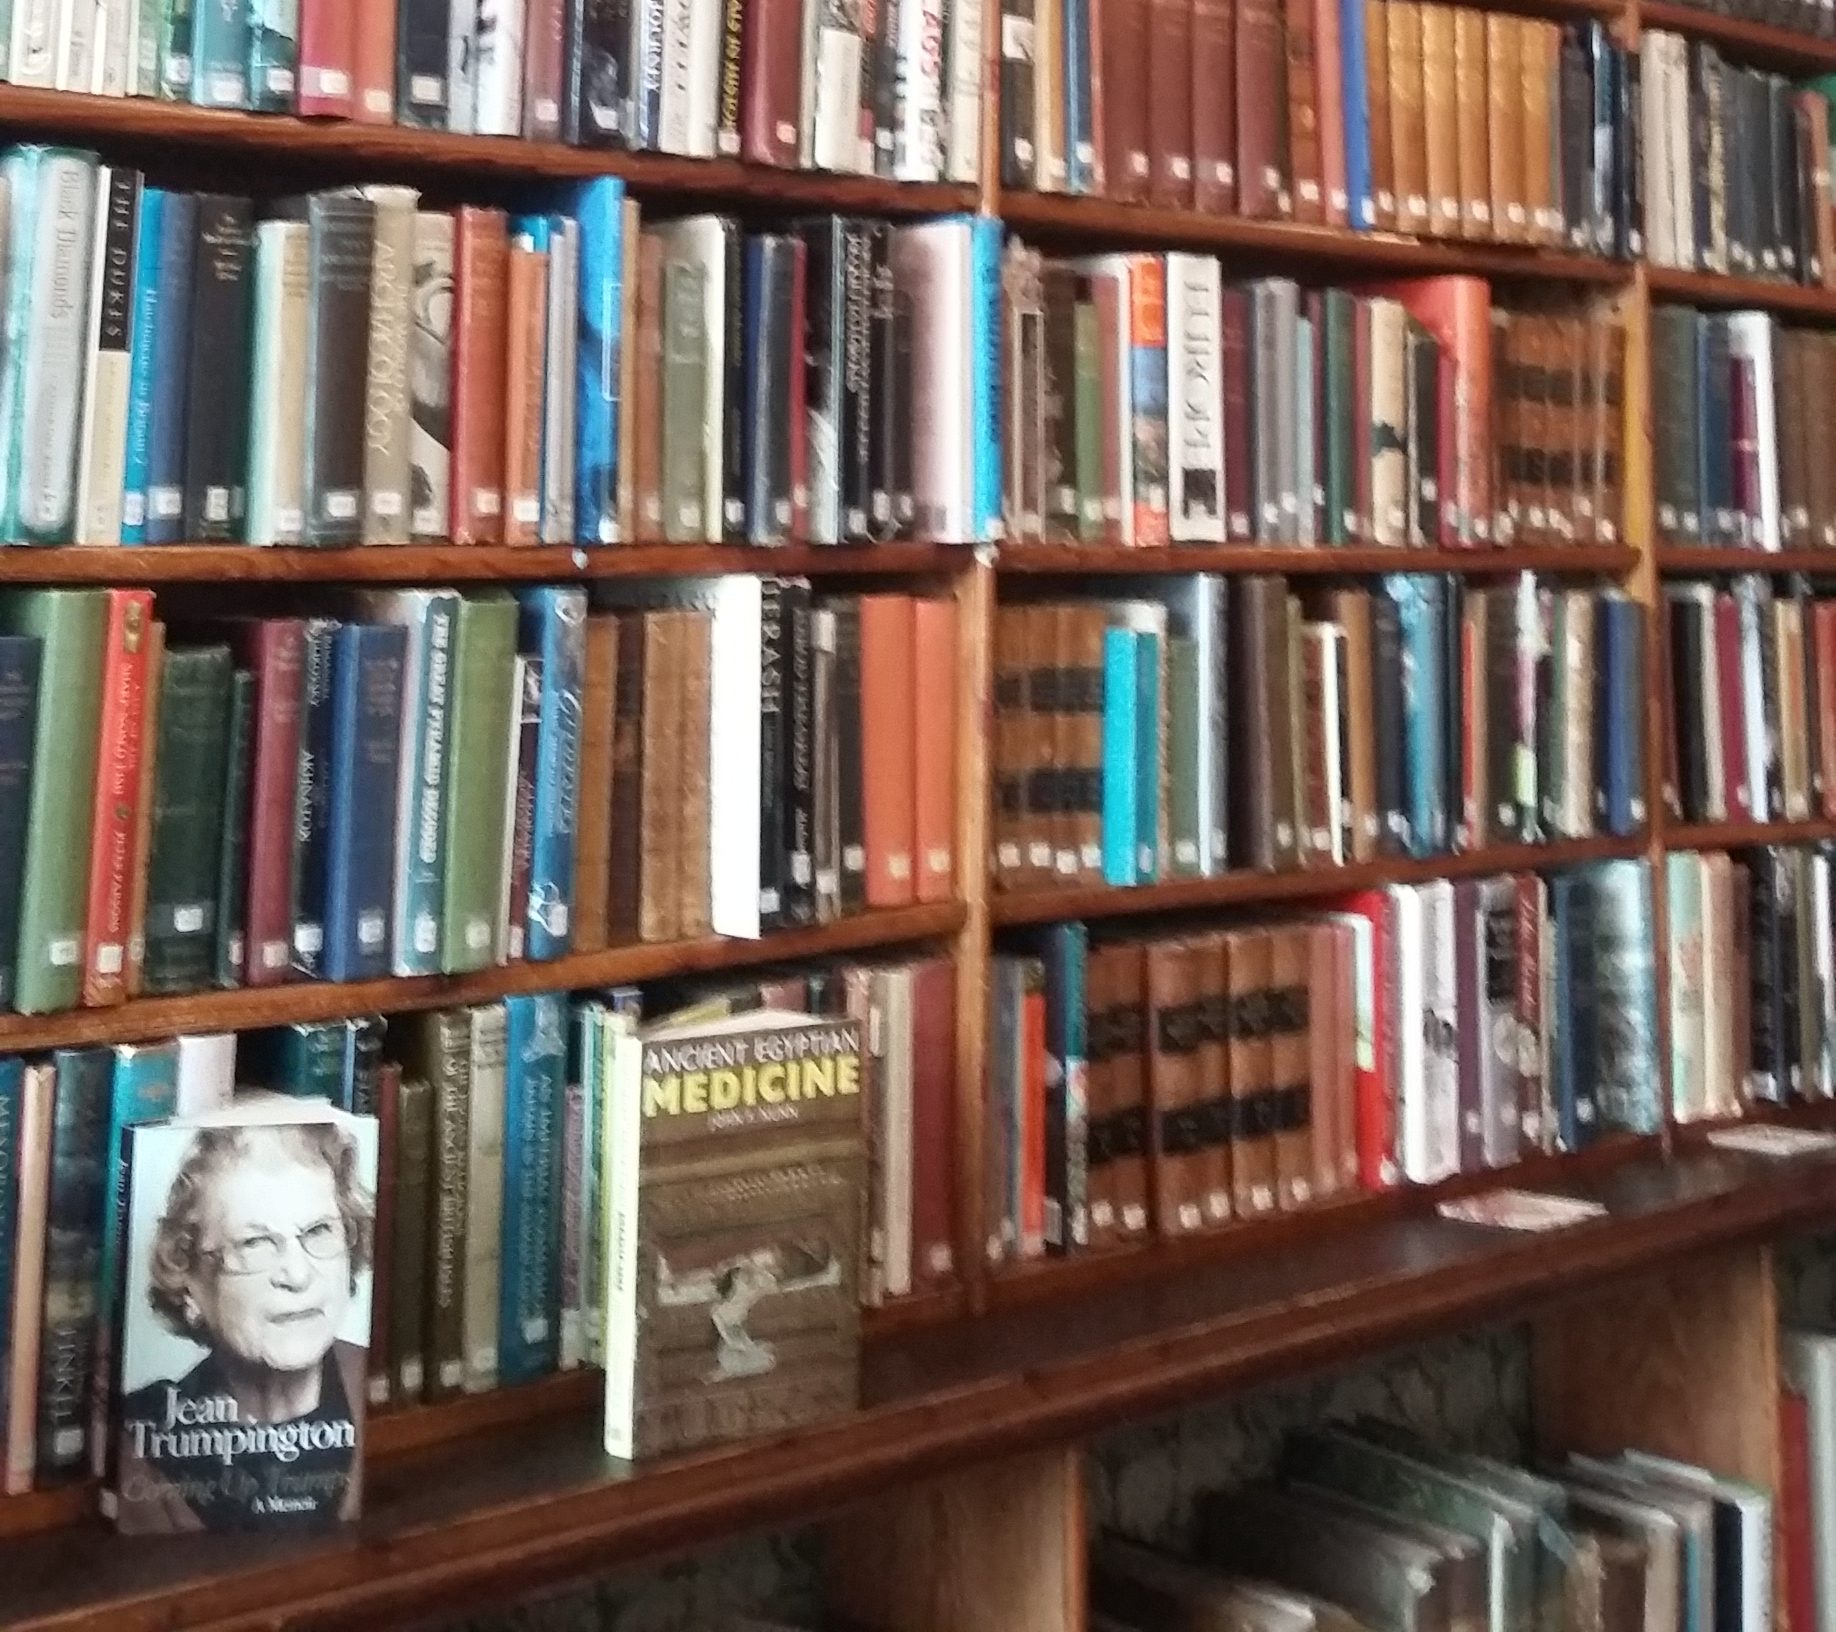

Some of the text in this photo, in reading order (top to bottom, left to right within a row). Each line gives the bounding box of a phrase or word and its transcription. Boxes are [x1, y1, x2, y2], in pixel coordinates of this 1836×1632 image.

[647, 0, 664, 93] JOURNEY
[50, 169, 80, 320] Black Diamonds
[104, 180, 131, 337] THE DUKES
[643, 1026, 861, 1074] ANCIENT EGYPTIAN
[641, 1052, 860, 1118] MEDICINE
[165, 1386, 239, 1430] Jean
[126, 1418, 356, 1466] Trumpington
